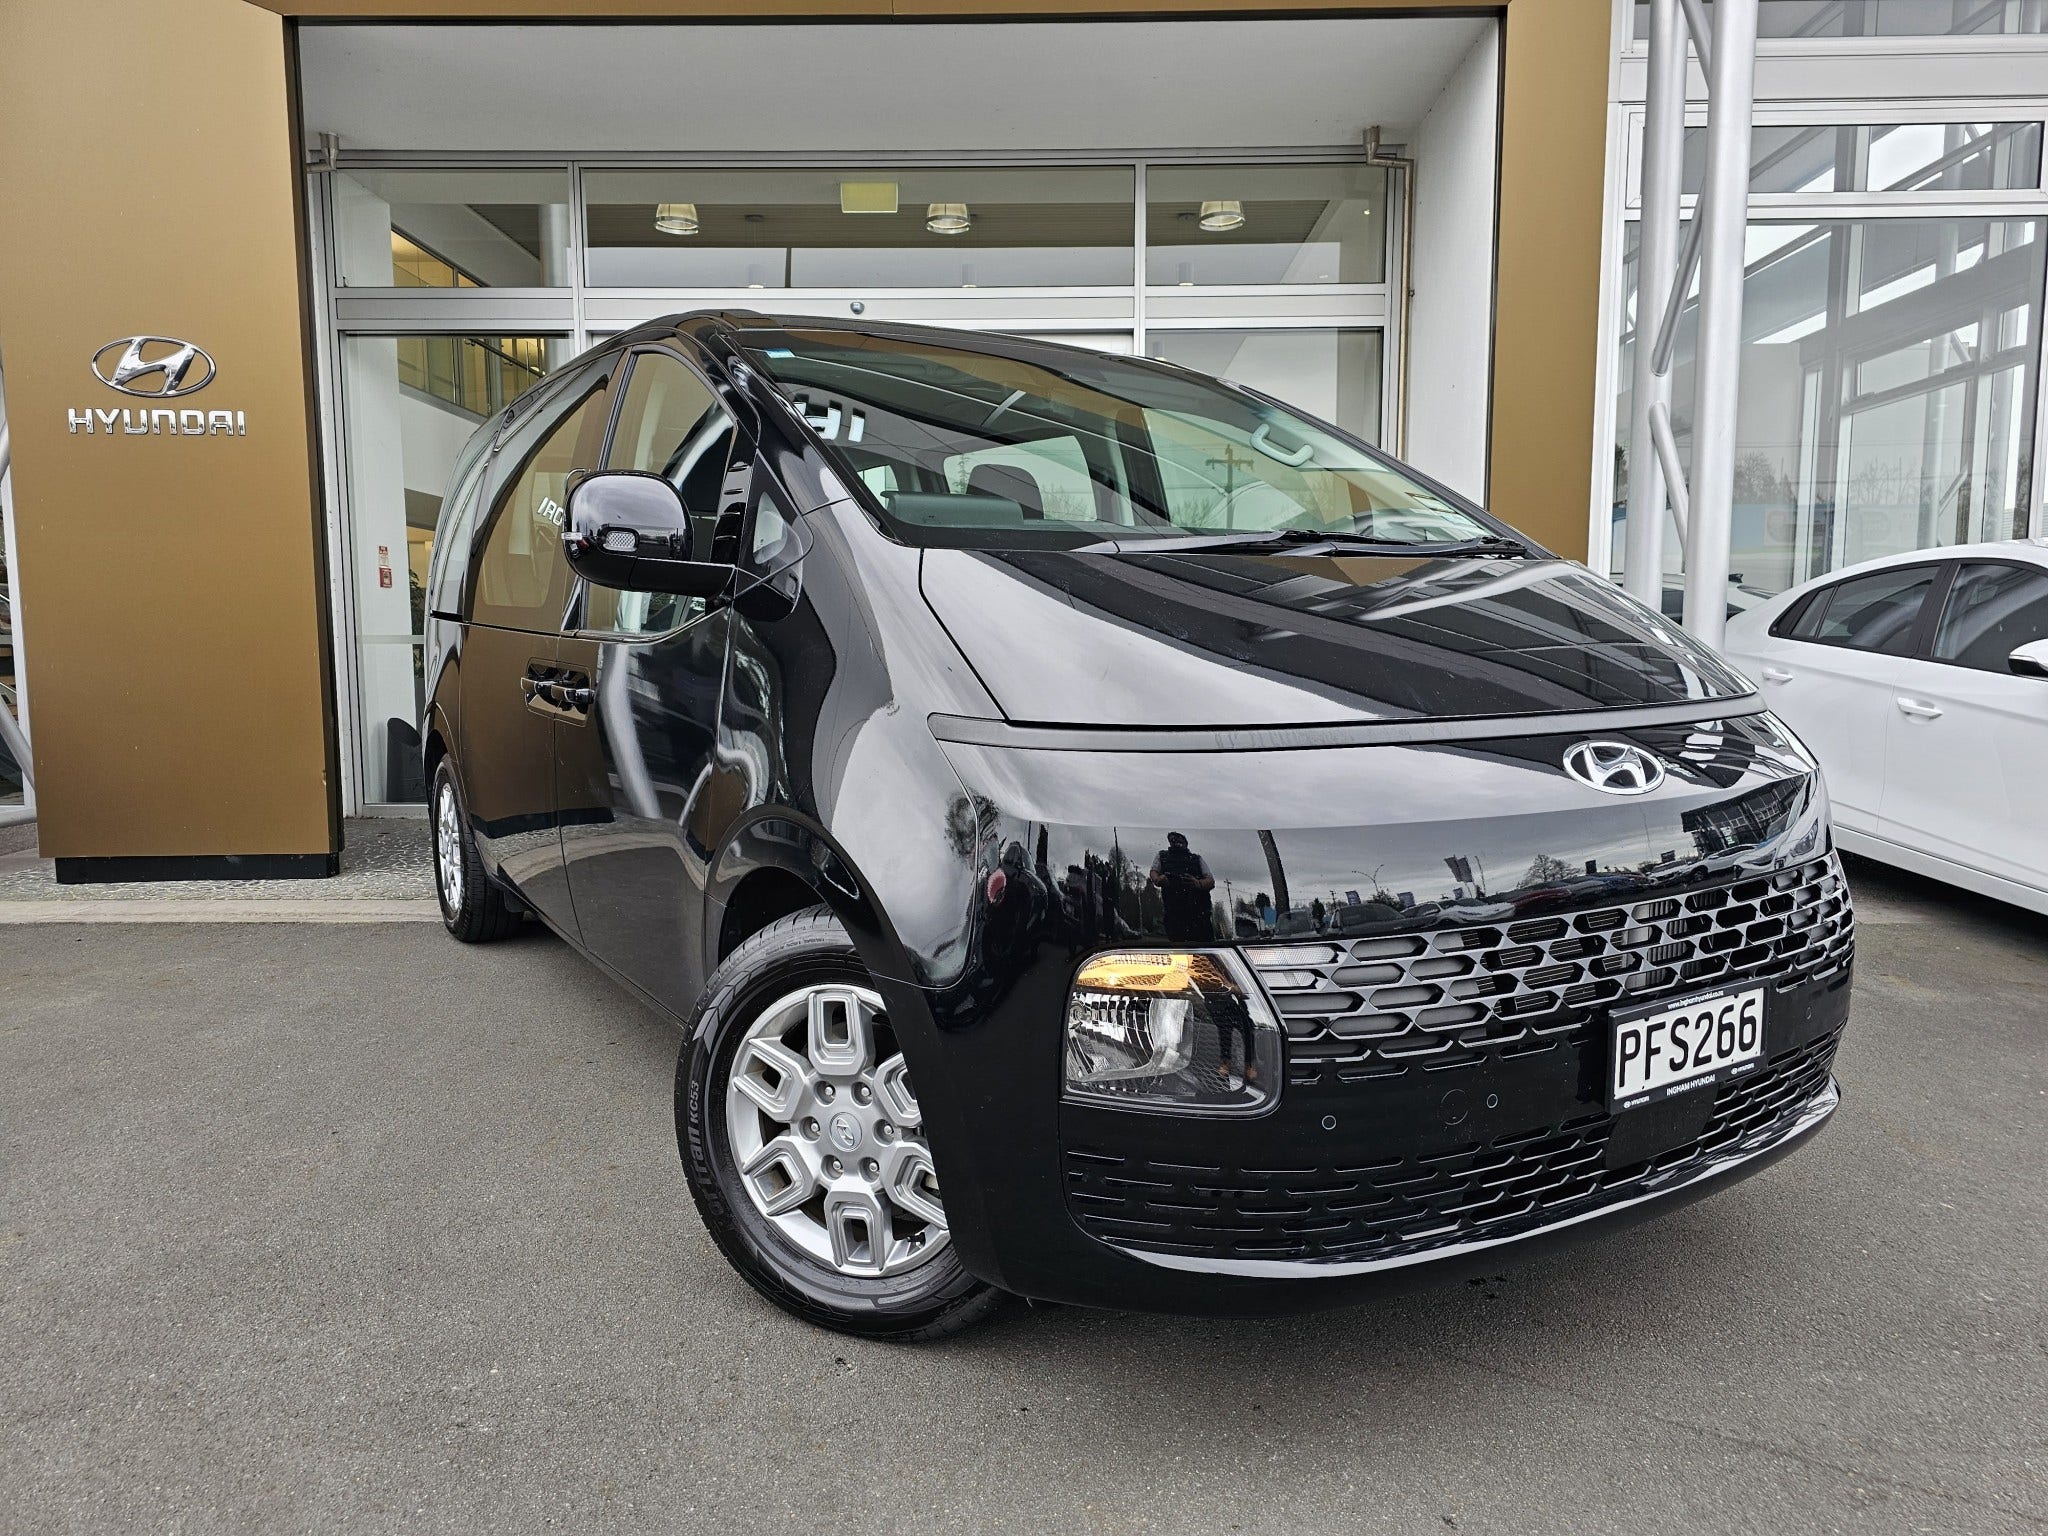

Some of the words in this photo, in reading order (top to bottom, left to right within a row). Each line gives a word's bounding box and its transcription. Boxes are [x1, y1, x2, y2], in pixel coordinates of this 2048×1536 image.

[67, 408, 247, 436] HYUNDAI
[1618, 997, 1757, 1089] PFS266
[688, 1079, 701, 1125] KC53
[1666, 1081, 1690, 1097] INGHAM
[1690, 1073, 1716, 1089] HYUNDAI
